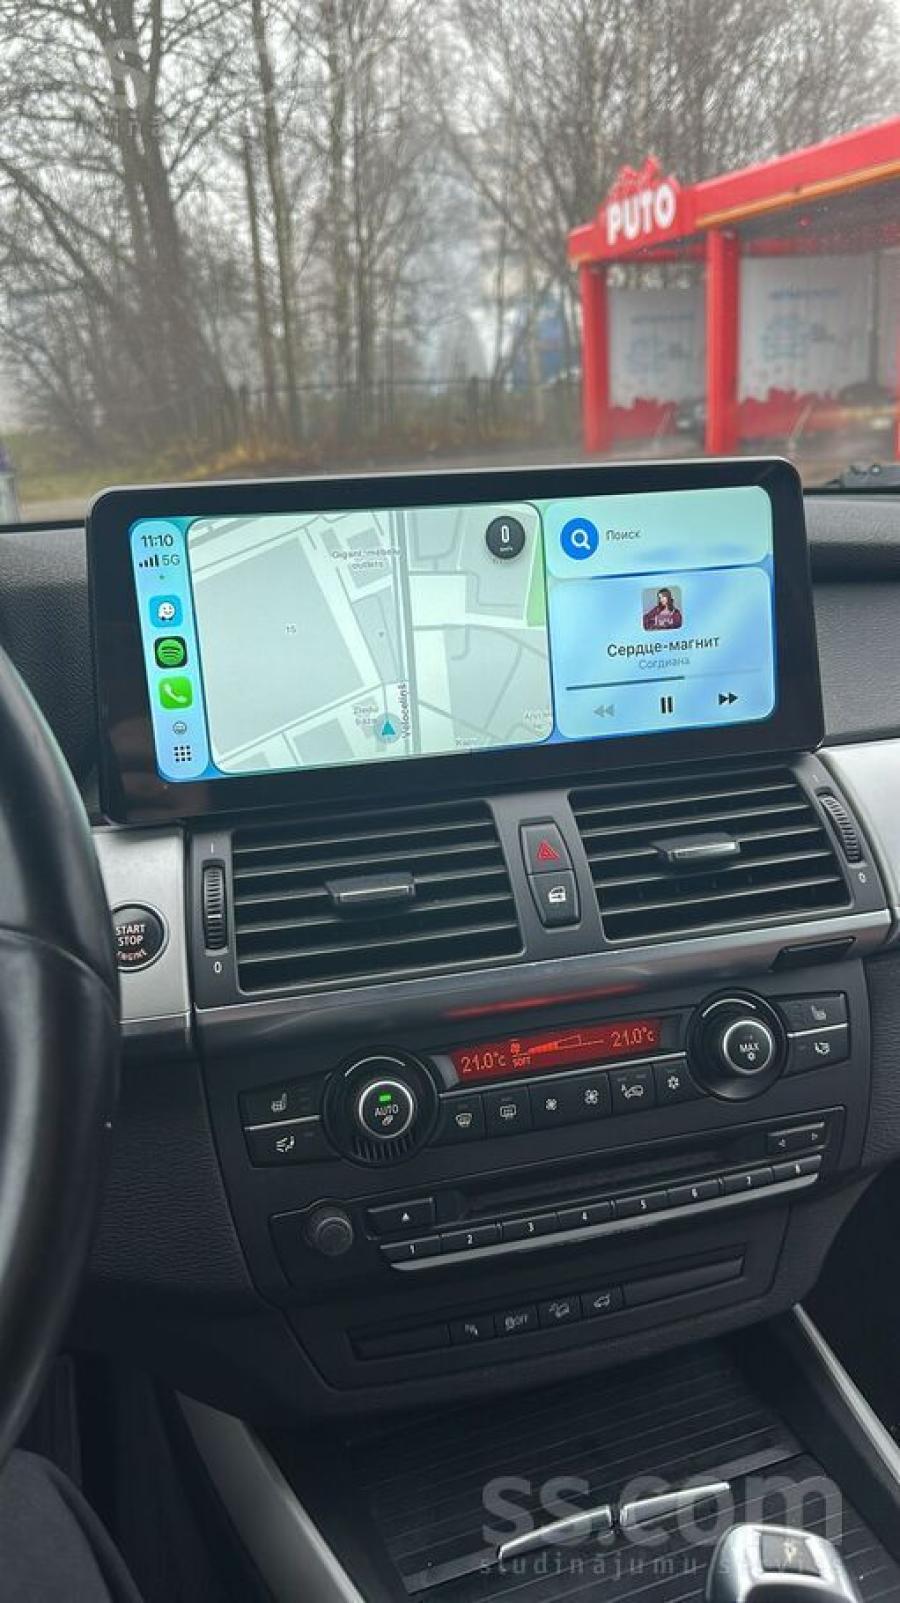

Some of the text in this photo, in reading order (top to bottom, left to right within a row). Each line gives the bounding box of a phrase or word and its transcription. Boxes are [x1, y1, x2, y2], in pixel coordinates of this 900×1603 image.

[606, 183, 677, 245] PUTO
[501, 524, 510, 543] 0
[606, 528, 641, 542] Поиск
[140, 534, 174, 548] 11:10
[162, 554, 180, 566] 5G
[607, 636, 720, 658] Сердце-магнит
[638, 656, 691, 670] Согдиана
[115, 924, 145, 936] START
[118, 936, 144, 946] STOP
[214, 962, 222, 974] 0
[739, 1042, 760, 1053] MAX
[512, 1056, 532, 1068] SOFT
[374, 1104, 399, 1117] AUTO
[746, 1176, 752, 1186] 7
[692, 1188, 698, 1199] 6
[640, 1199, 648, 1210] 5
[582, 1211, 588, 1222] 4
[527, 1221, 534, 1233] 3
[466, 1234, 473, 1245] 2
[410, 1244, 416, 1256] 1
